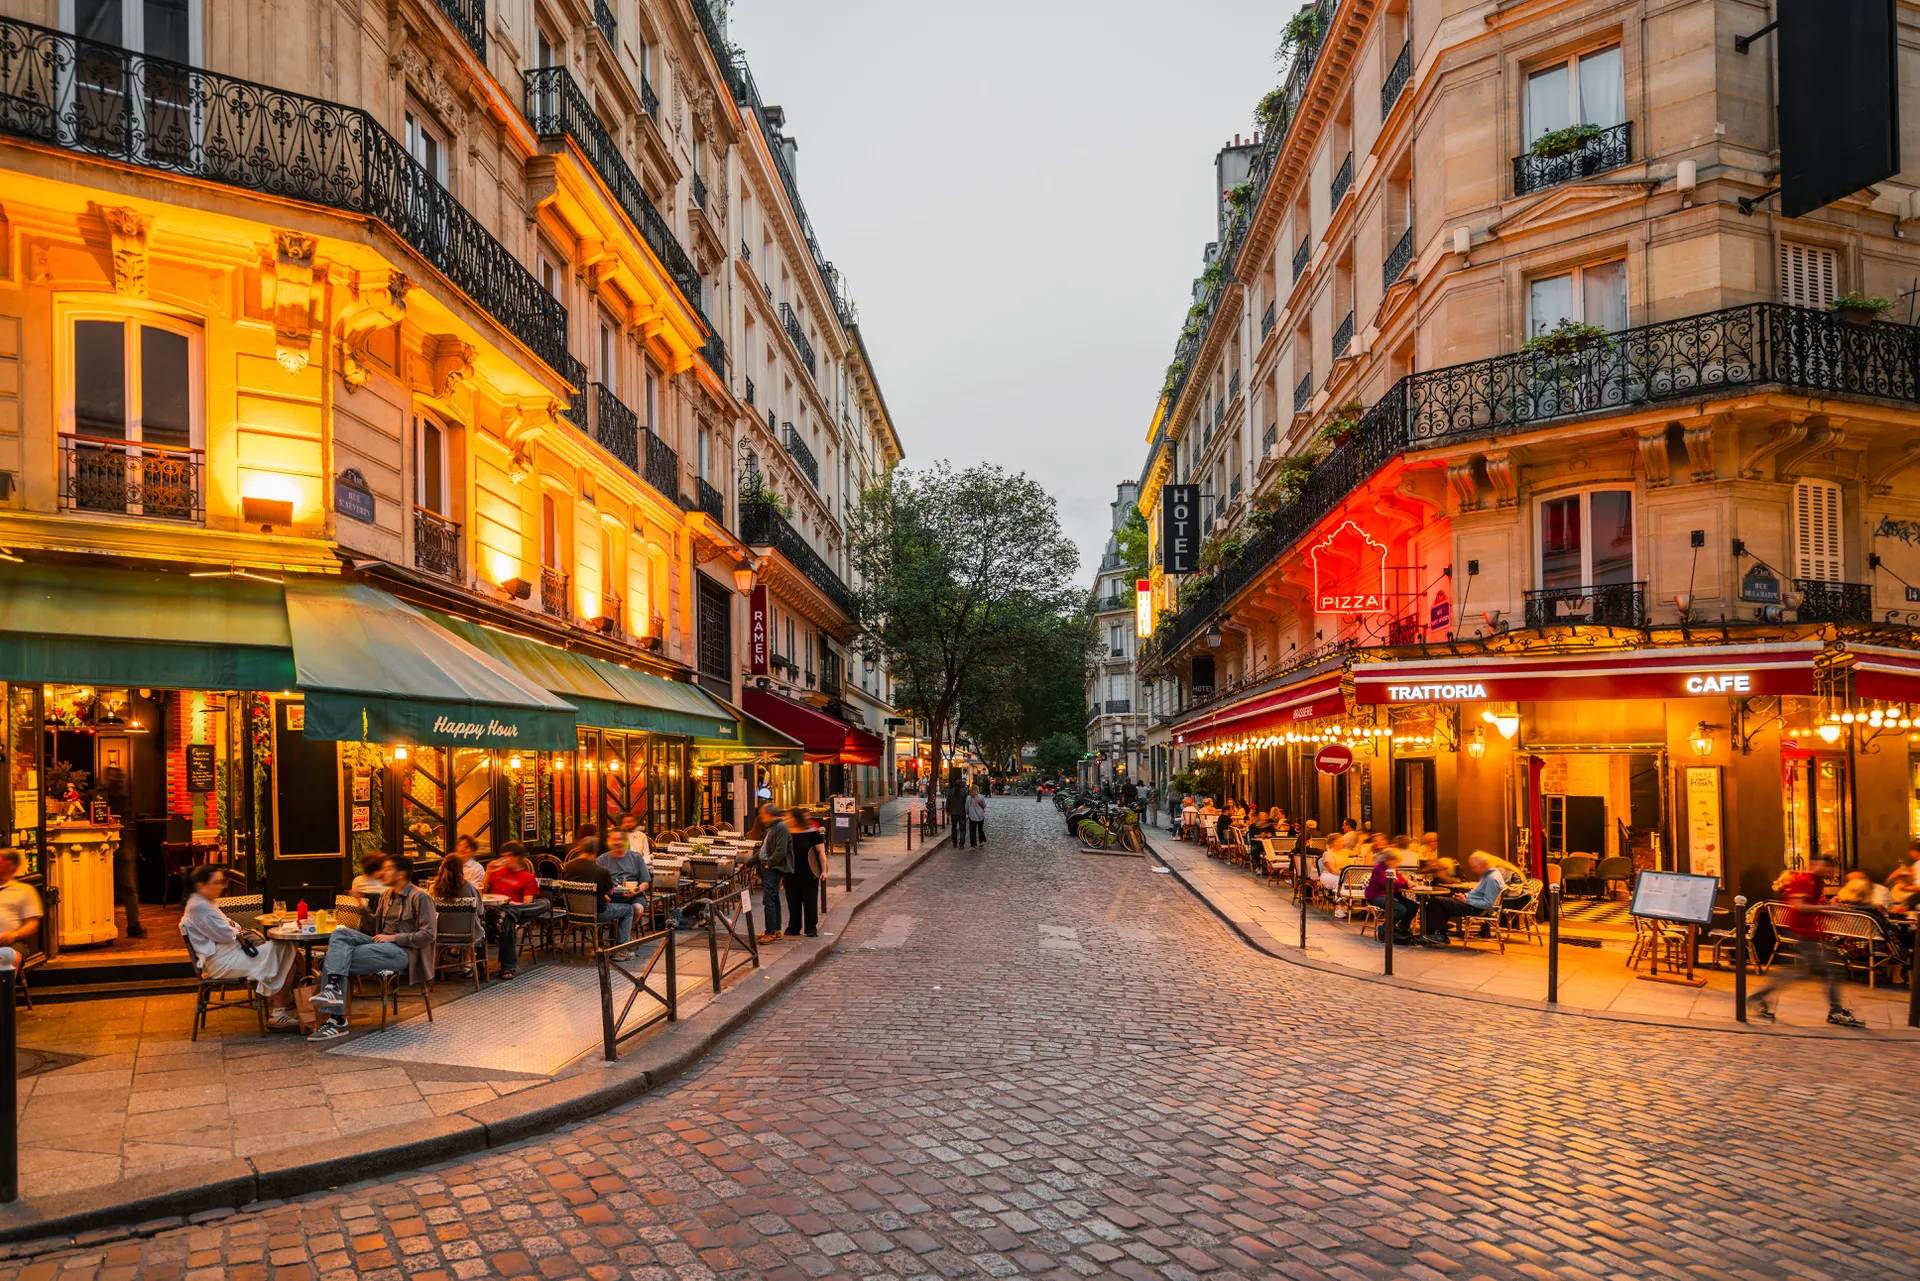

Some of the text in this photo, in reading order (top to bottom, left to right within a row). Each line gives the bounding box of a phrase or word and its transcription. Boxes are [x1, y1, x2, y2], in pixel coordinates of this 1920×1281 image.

[1174, 489, 1188, 570] HOTEL
[1321, 595, 1379, 609] PIZZA
[754, 611, 764, 664] RAMEN
[1388, 684, 1487, 700] TRATTORIA
[1686, 675, 1750, 693] CAFE
[1292, 705, 1313, 719] BRASSERIE
[433, 715, 518, 740] Happy Hour
